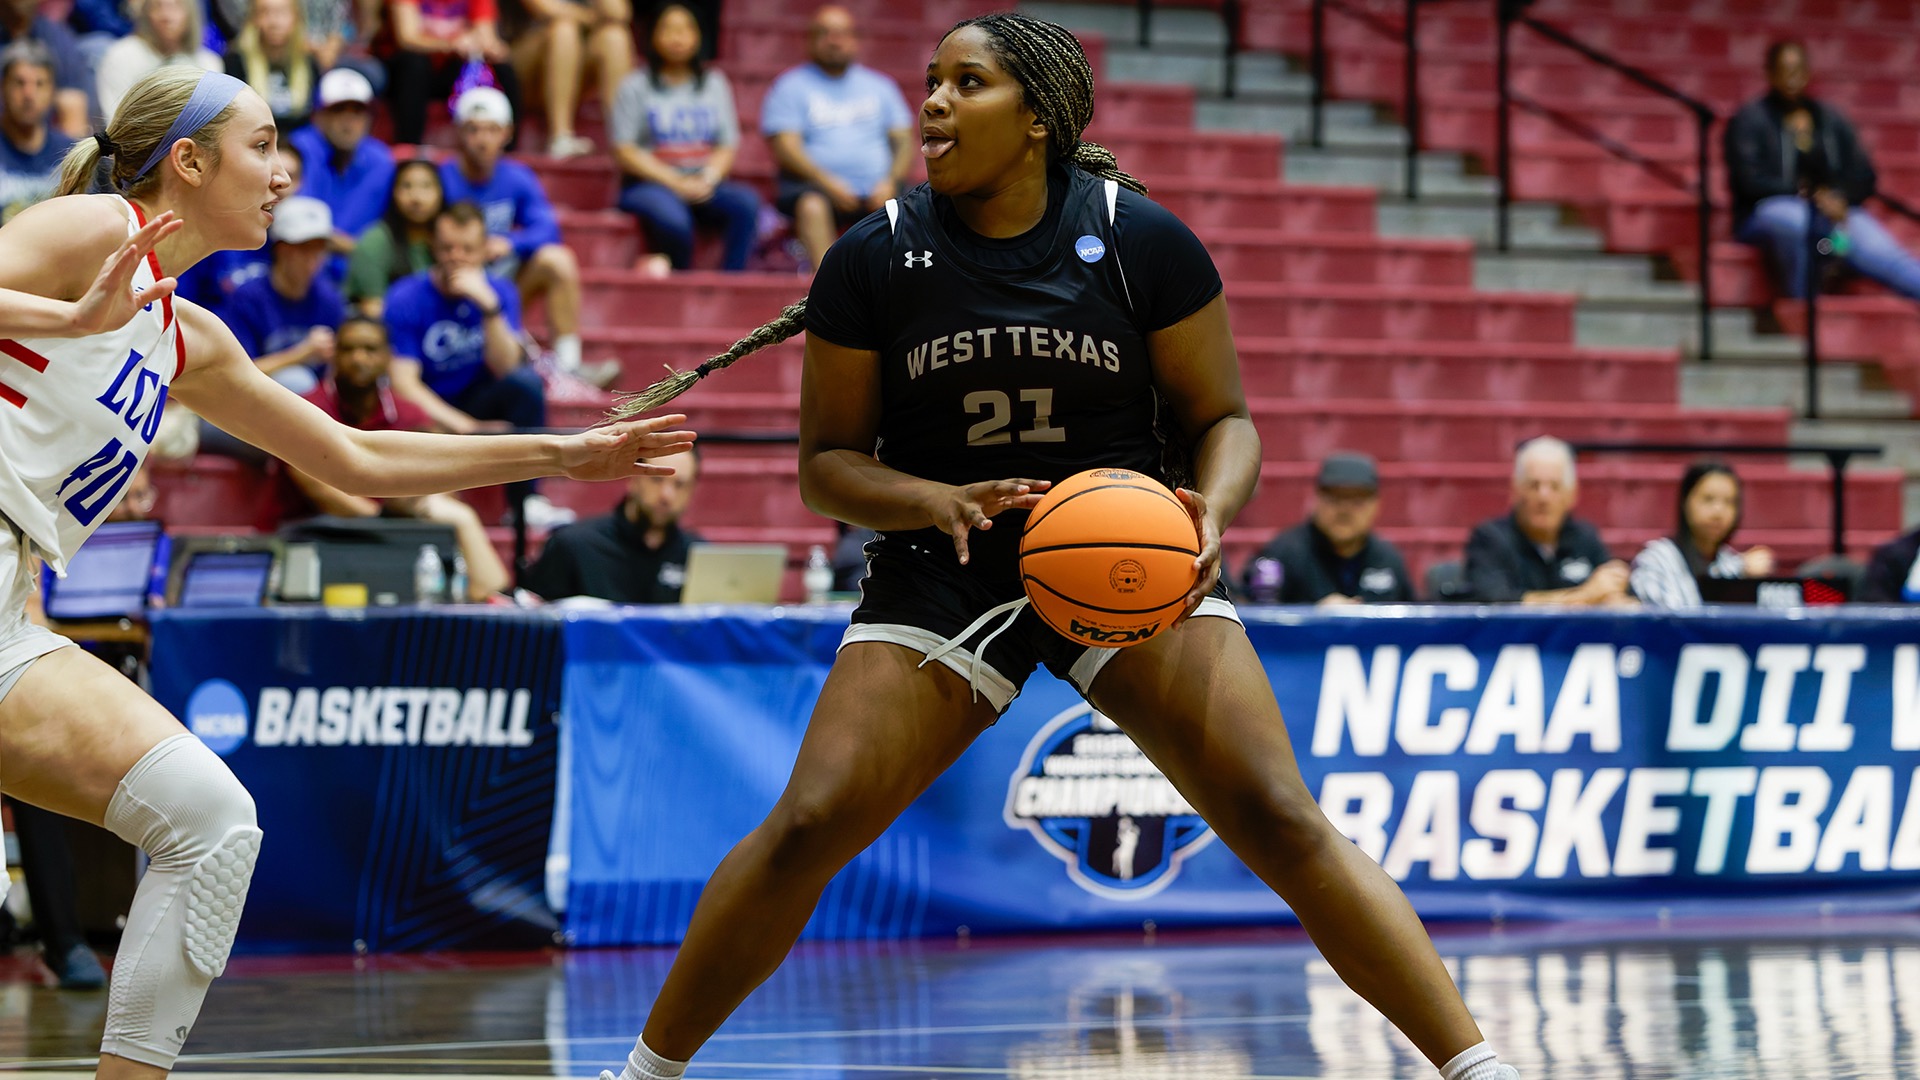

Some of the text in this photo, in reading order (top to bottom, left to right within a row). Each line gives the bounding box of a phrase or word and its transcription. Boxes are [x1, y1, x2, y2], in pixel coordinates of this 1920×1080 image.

[1080, 245, 1104, 257] NCAA
[907, 326, 1120, 380] WEST TEXAS
[95, 348, 169, 445] LCU
[963, 388, 1066, 446] 21
[55, 437, 138, 527] 40
[1070, 618, 1161, 643] NCAA
[254, 686, 535, 747] BASKETBALL
[1665, 643, 1868, 752] DII
